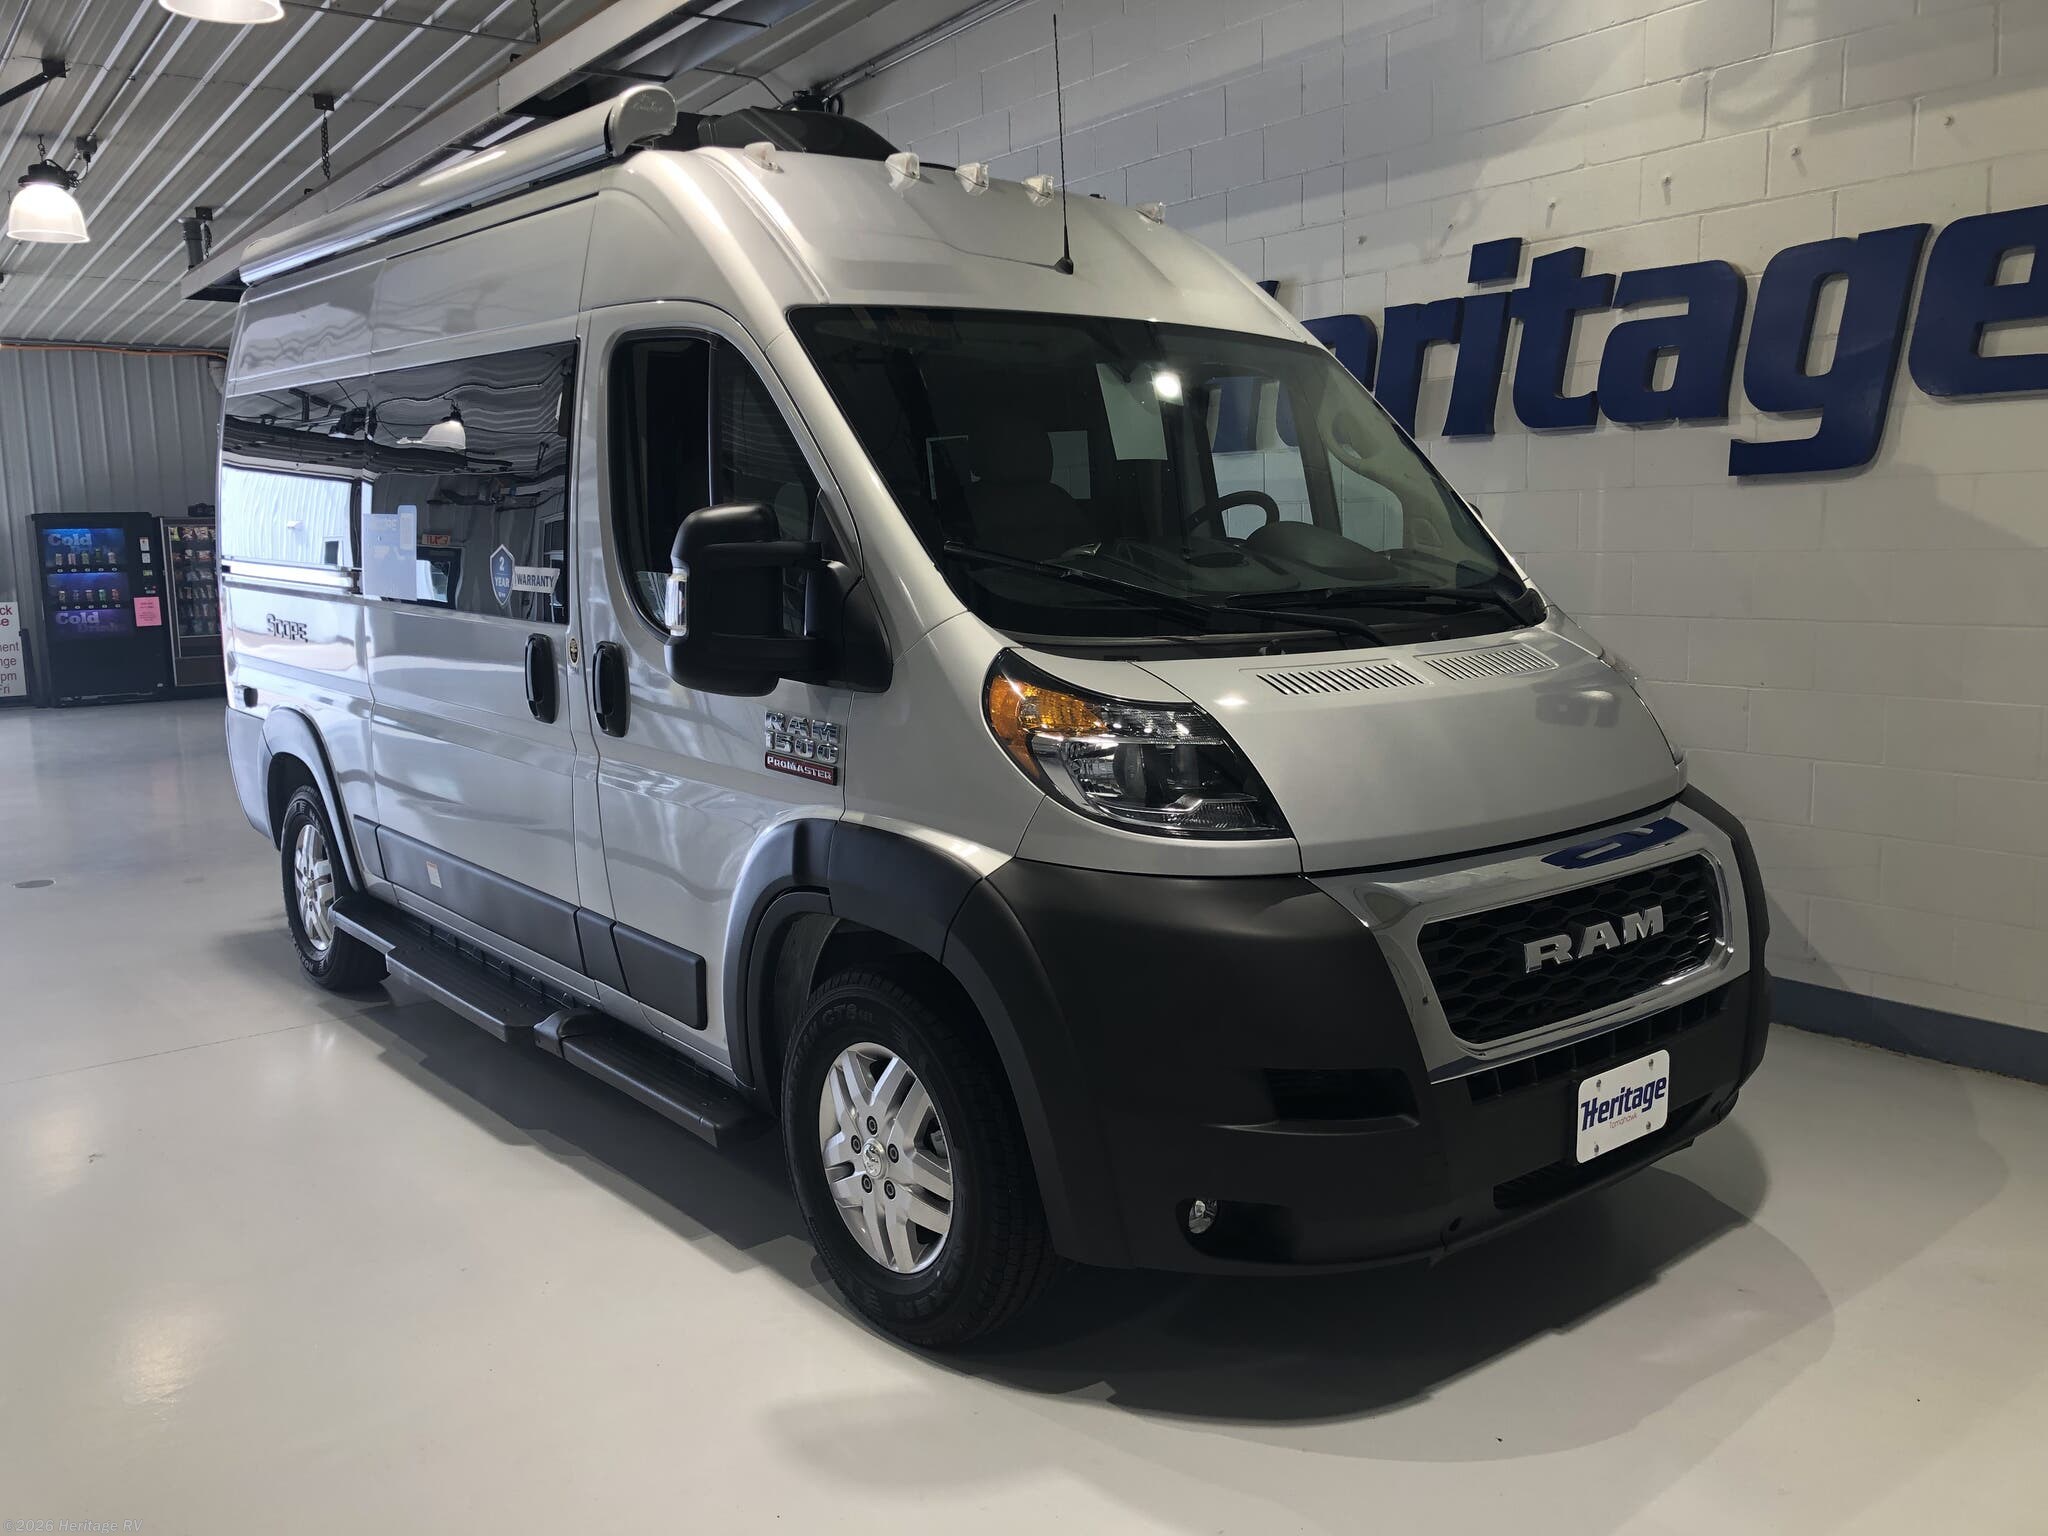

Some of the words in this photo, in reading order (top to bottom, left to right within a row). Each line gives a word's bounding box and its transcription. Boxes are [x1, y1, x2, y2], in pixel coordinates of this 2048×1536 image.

[47, 533, 92, 546] Cold
[499, 556, 505, 571] 2
[494, 576, 510, 588] YEAR
[516, 573, 555, 588] WARRANTY
[55, 611, 100, 625] Cold
[765, 711, 840, 744] RAM
[765, 730, 840, 764] 1500
[1523, 905, 1665, 974] RAM
[1580, 1076, 1667, 1131] Heritage
